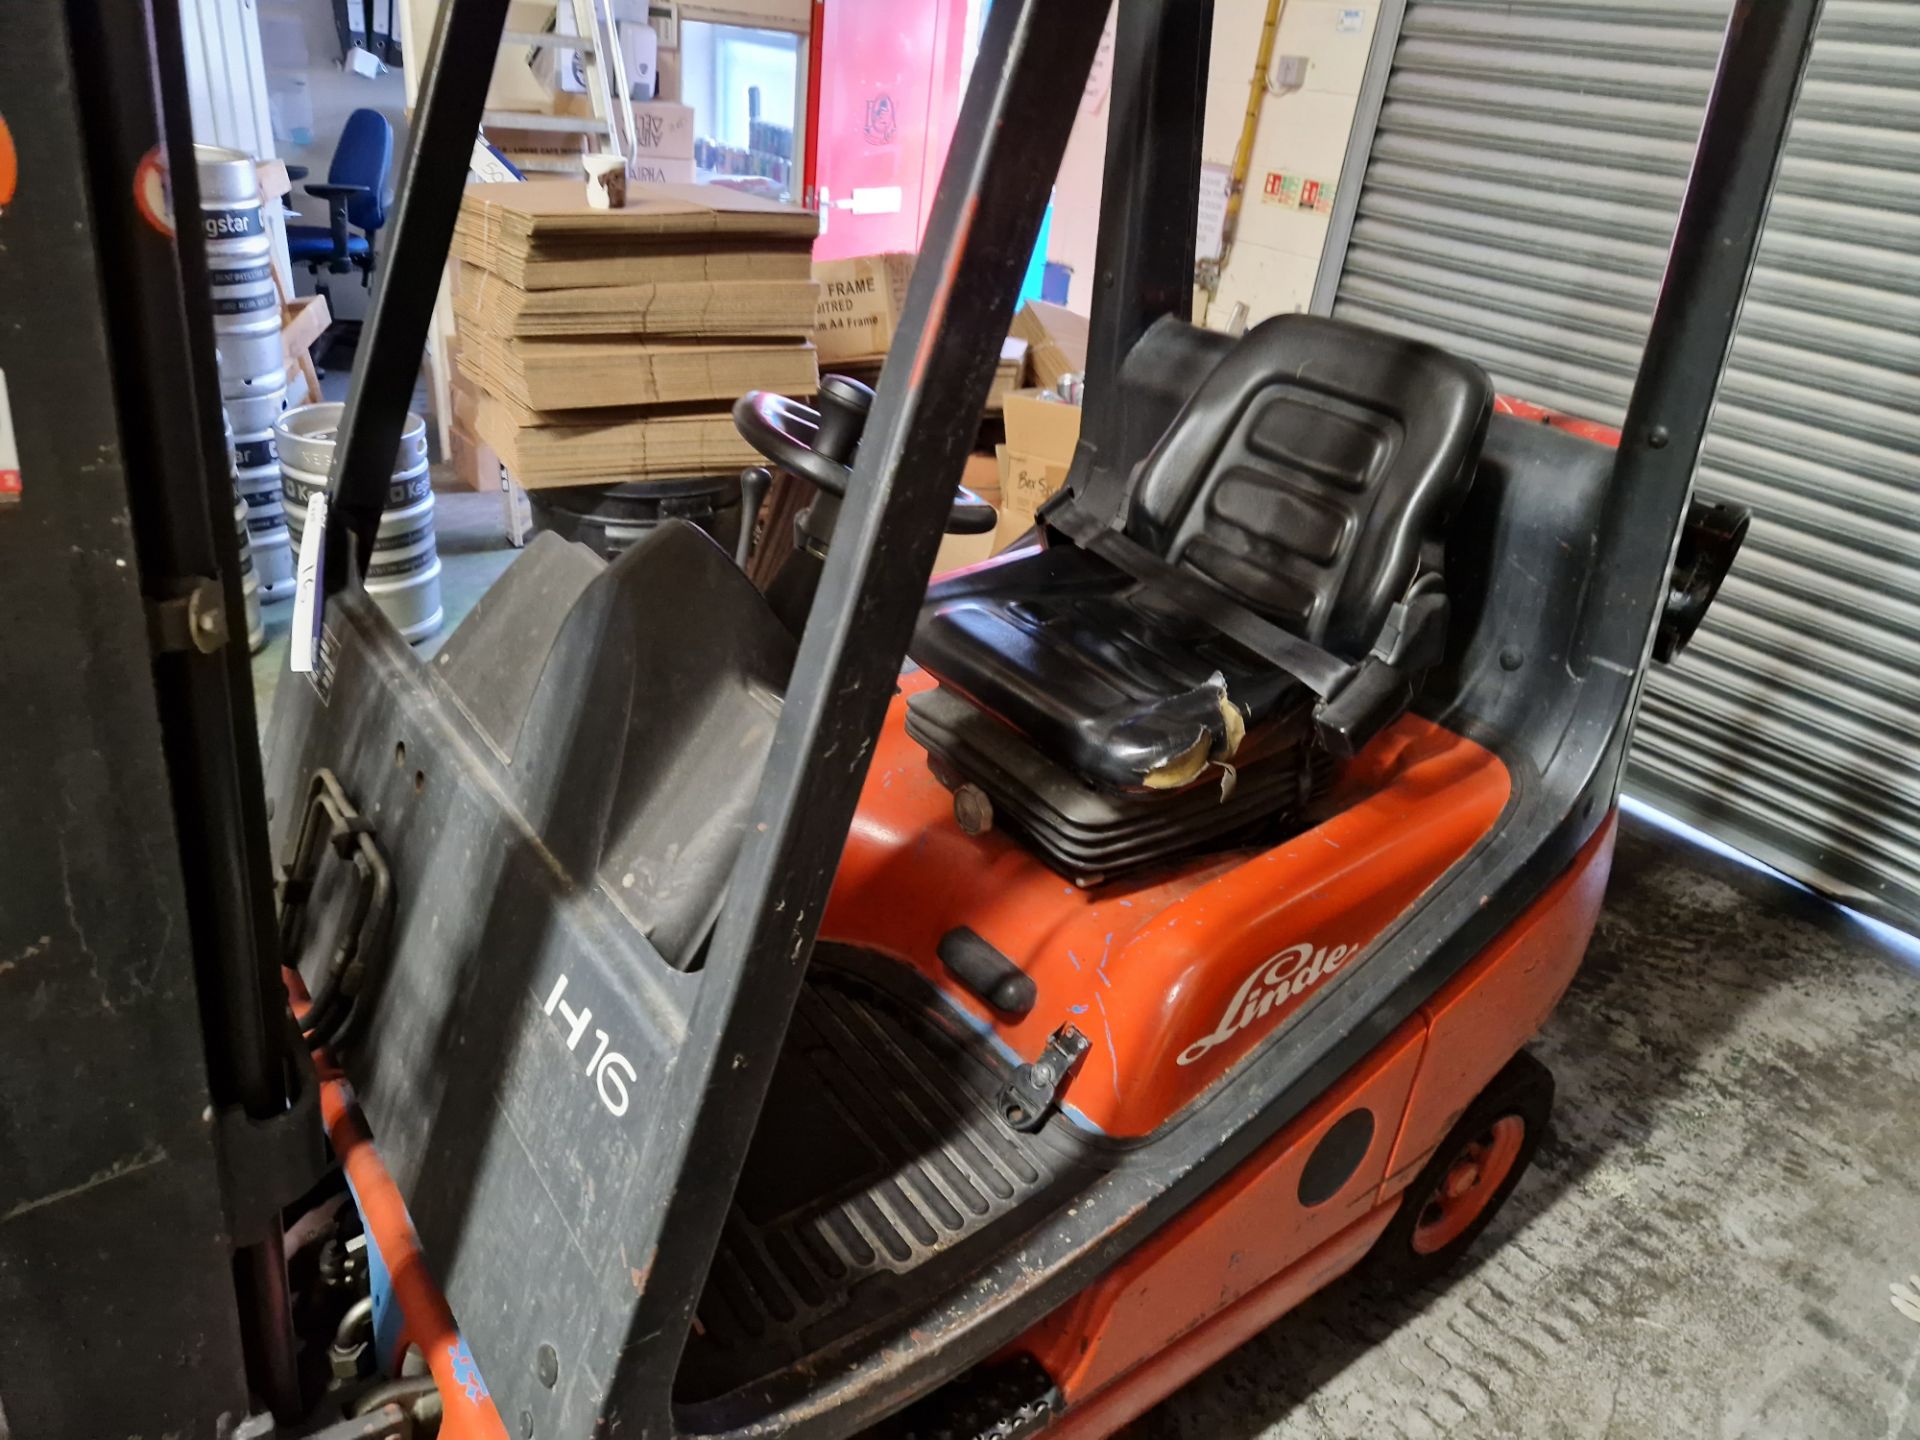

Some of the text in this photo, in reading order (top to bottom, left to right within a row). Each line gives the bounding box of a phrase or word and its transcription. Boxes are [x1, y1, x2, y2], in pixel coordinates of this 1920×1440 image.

[206, 213, 250, 238] gstar
[827, 277, 876, 297] FRAME
[847, 315, 879, 329] Frame
[1176, 943, 1359, 1066] Linde
